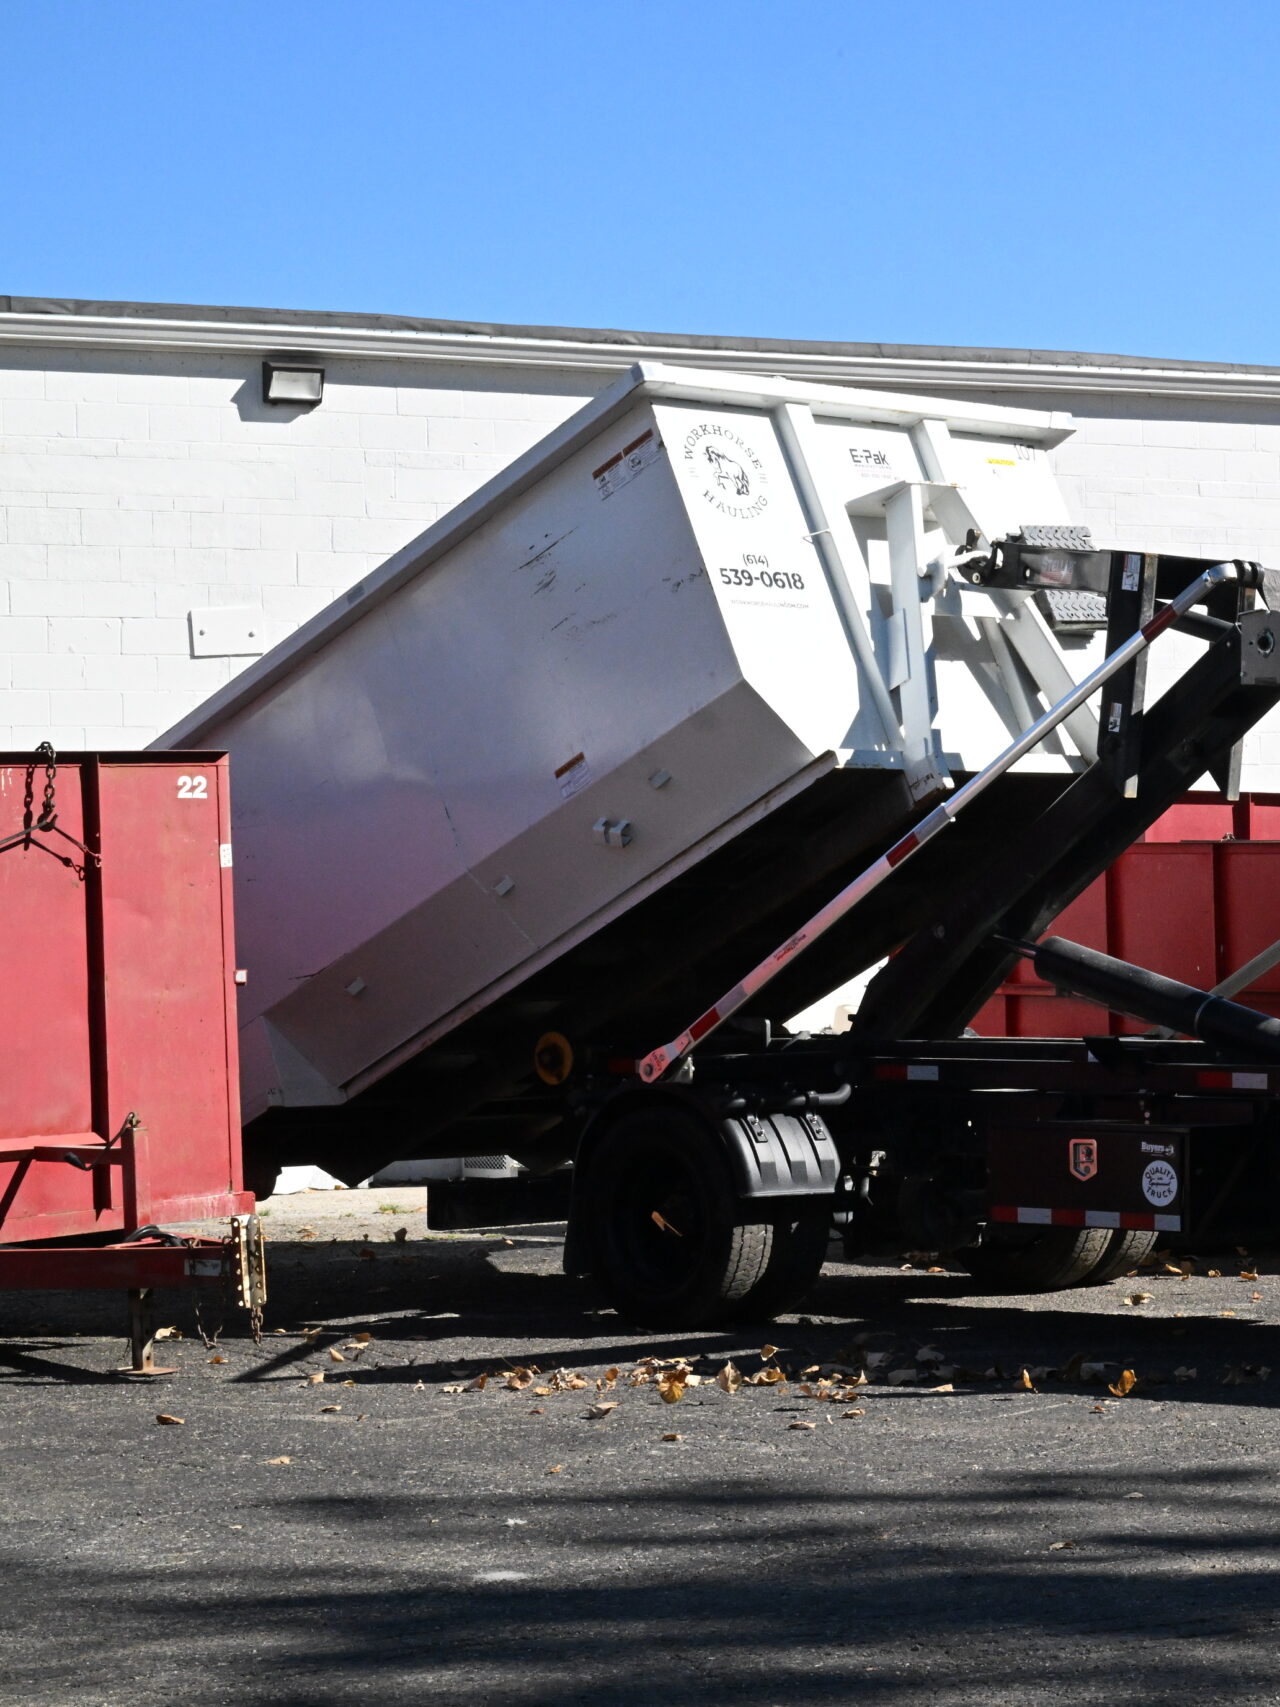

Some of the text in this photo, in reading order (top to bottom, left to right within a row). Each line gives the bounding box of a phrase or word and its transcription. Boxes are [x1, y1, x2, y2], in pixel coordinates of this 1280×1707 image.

[684, 424, 763, 470] WORKHORSE
[849, 448, 890, 466] E-Pak
[702, 490, 768, 519] HAULING
[742, 553, 769, 568] (614)
[719, 567, 805, 590] 539-0618
[177, 775, 208, 799] 22
[1145, 1167, 1175, 1181] QUALITY
[1147, 1187, 1173, 1198] TRUCK
